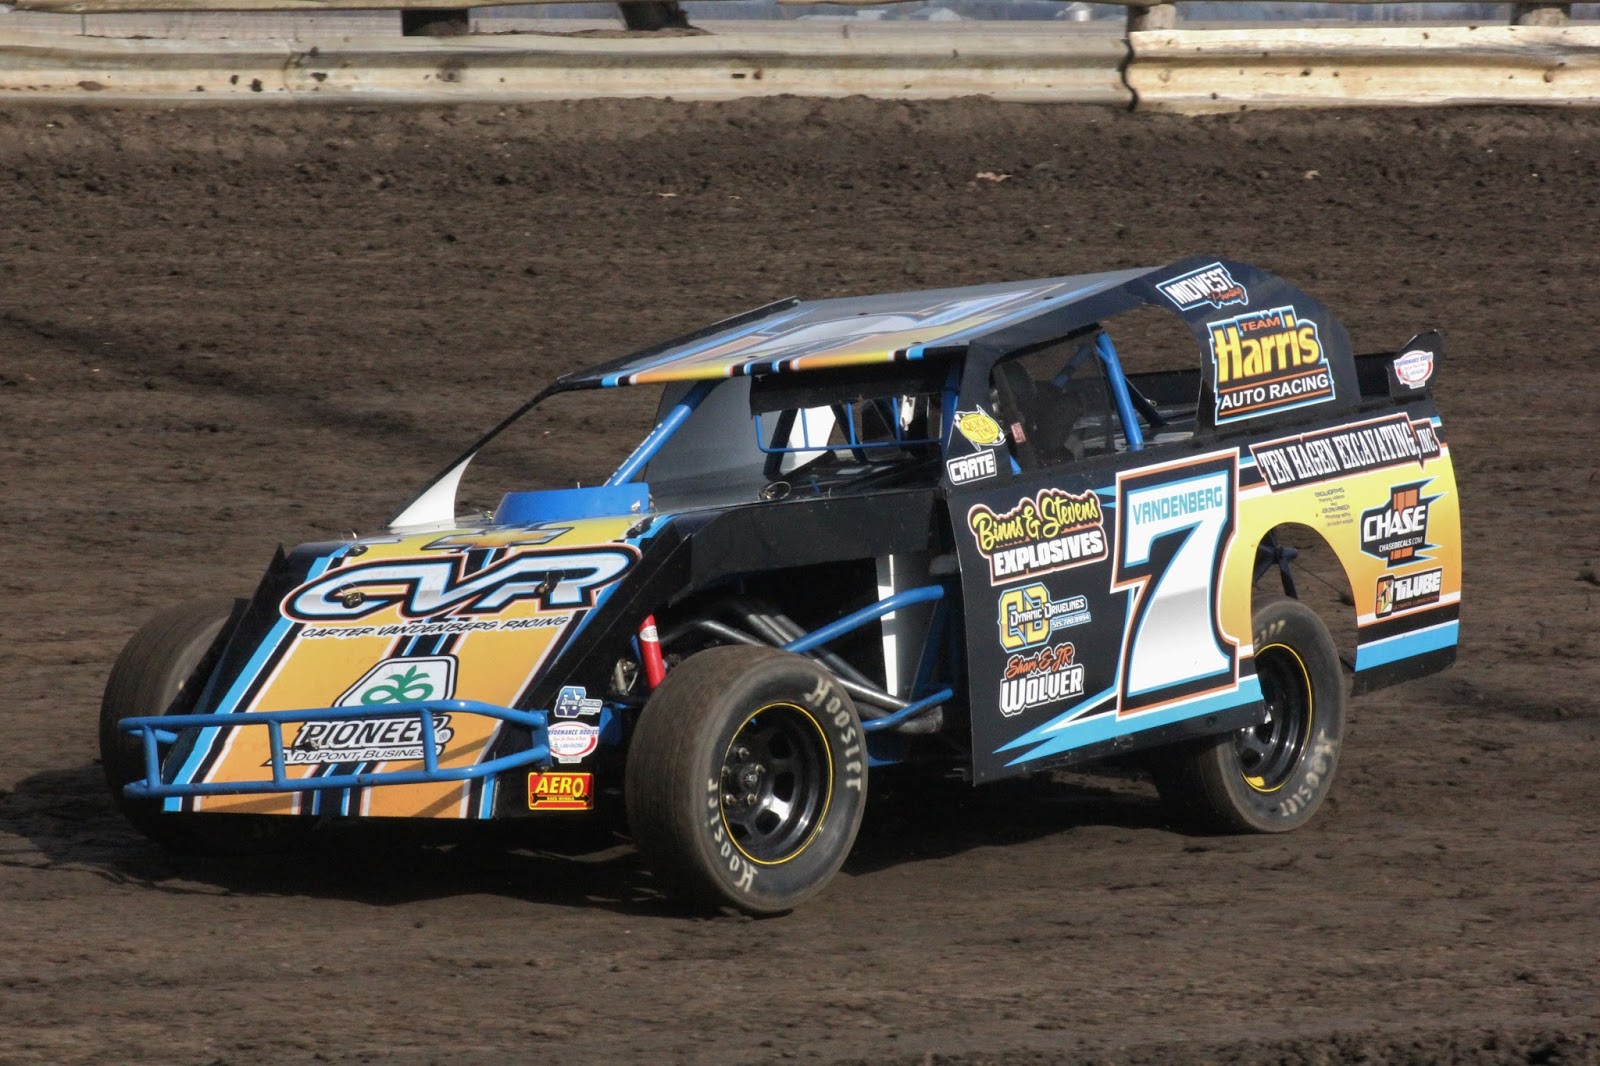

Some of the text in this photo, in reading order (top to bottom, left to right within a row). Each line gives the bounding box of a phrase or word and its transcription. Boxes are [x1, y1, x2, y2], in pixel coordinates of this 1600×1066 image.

[1164, 267, 1234, 305] MIDWEST
[1239, 317, 1280, 332] TEAM
[1213, 314, 1321, 383] Harris
[1220, 373, 1329, 410] AUTO RACING
[963, 418, 989, 432] QUICK
[975, 425, 996, 439] TIME
[949, 453, 995, 482] CRATE
[1257, 447, 1296, 486] TEN
[1286, 437, 1339, 480] HAGEN
[972, 512, 1024, 551] Binns
[1041, 496, 1099, 538] Stevens
[1132, 485, 1223, 525] VANDENBERG
[1363, 505, 1426, 543] CHASE
[993, 530, 1104, 577] EXPLOSIVES
[1116, 458, 1236, 710] 7
[301, 616, 569, 639] CARTER VANDENBERG RACING
[1010, 598, 1085, 627] DYNAMIC DRIVELINES
[1052, 645, 1073, 672] JR
[1002, 667, 1082, 713] WOLVER
[363, 749, 428, 759] BUSINES
[535, 776, 584, 798] AERO
